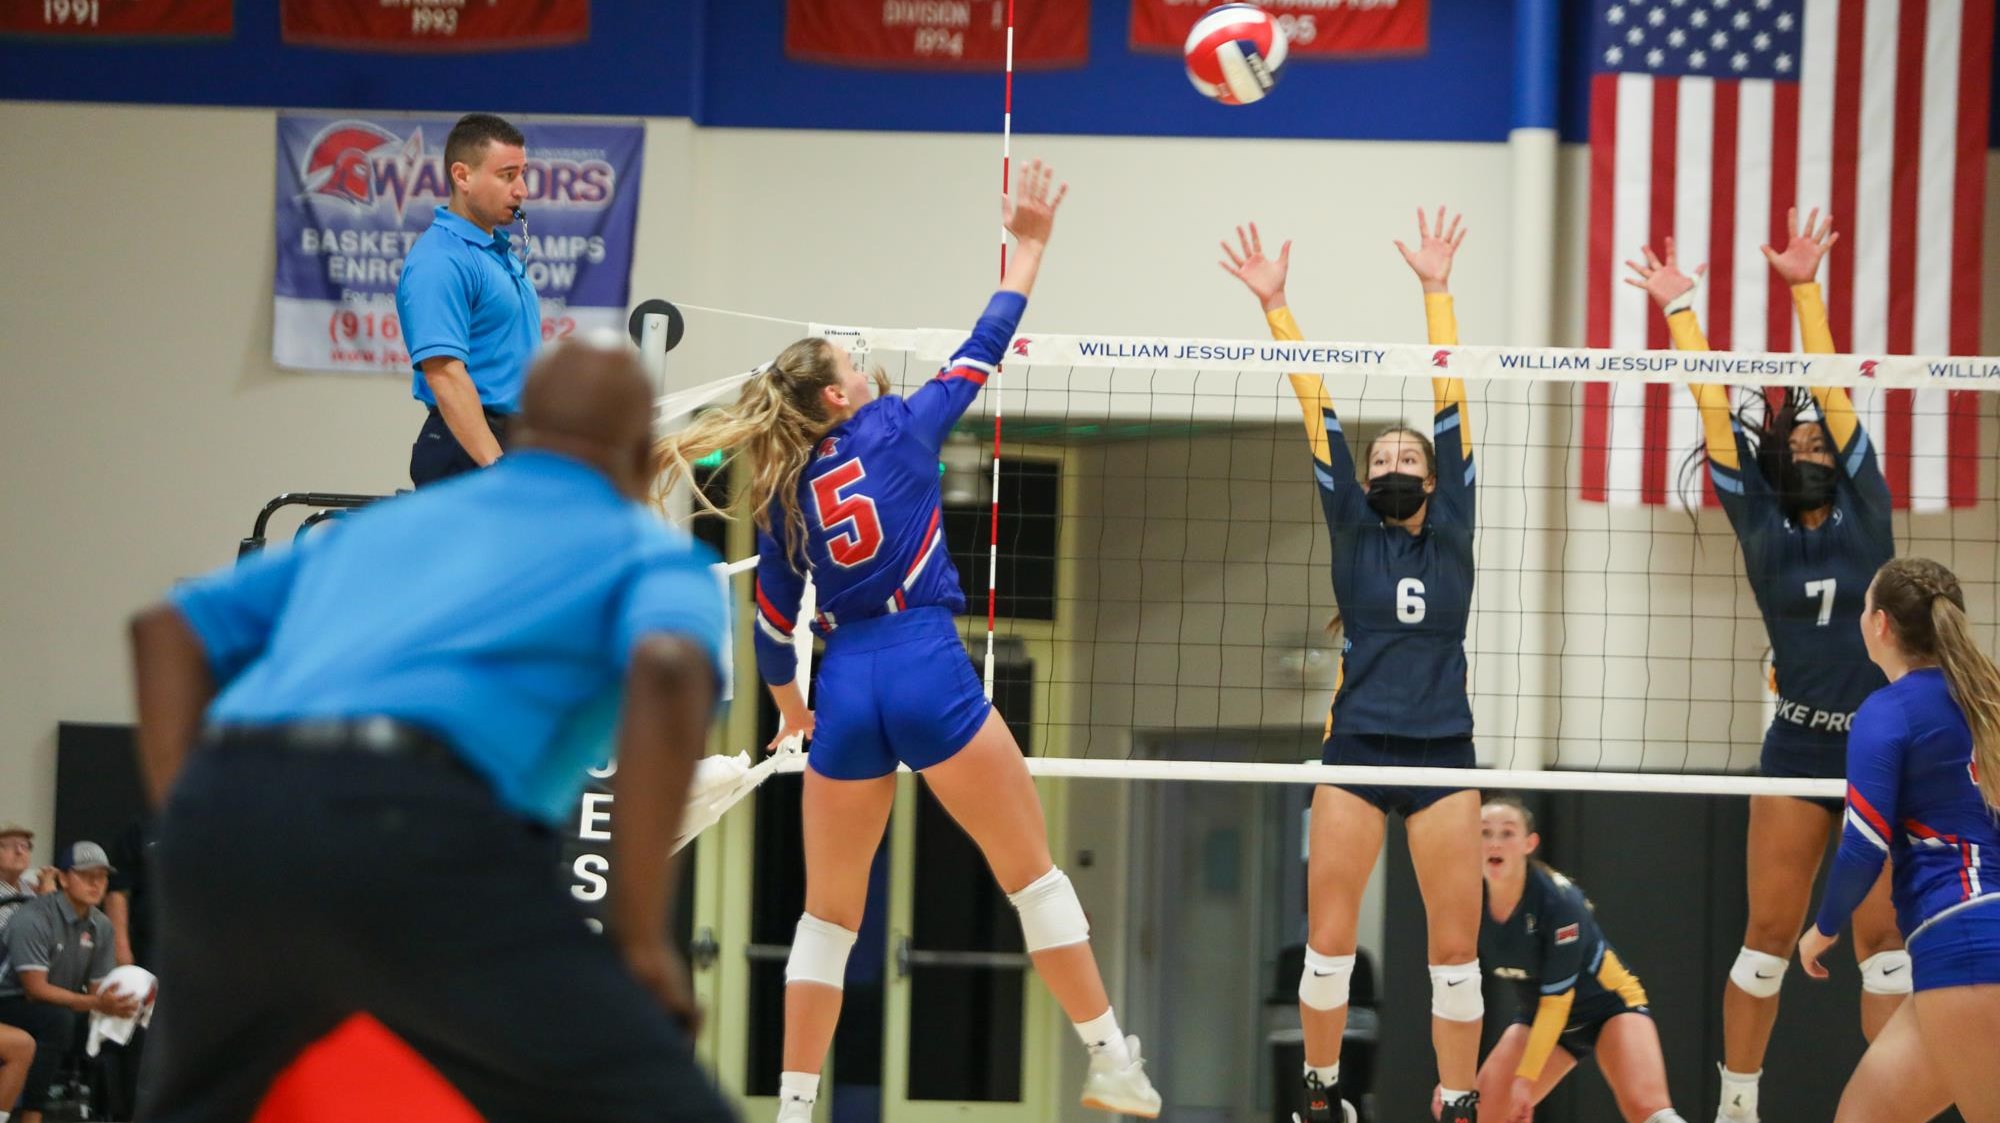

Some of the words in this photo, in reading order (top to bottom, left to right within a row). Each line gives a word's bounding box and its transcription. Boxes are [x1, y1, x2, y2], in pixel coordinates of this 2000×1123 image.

[412, 6, 459, 35] 1993
[882, 0, 971, 27] DIVISION
[1279, 14, 1317, 44] 95
[302, 228, 418, 256] BASKET
[508, 234, 606, 263] CAMPS
[328, 256, 404, 283] ENRO
[527, 262, 577, 290] OW
[1079, 342, 1169, 359] WILLIAM
[1174, 346, 1255, 361] JESSUP
[1260, 348, 1386, 364] UNIVERSITY
[1499, 354, 1590, 371] WILLIAM
[1596, 357, 1678, 372] JESSUP
[1683, 359, 1813, 375] UNIVERSITY
[1928, 363, 2000, 377] WILLIA
[810, 457, 884, 567] 5
[1397, 577, 1426, 624] 6
[1805, 578, 1837, 626] 7
